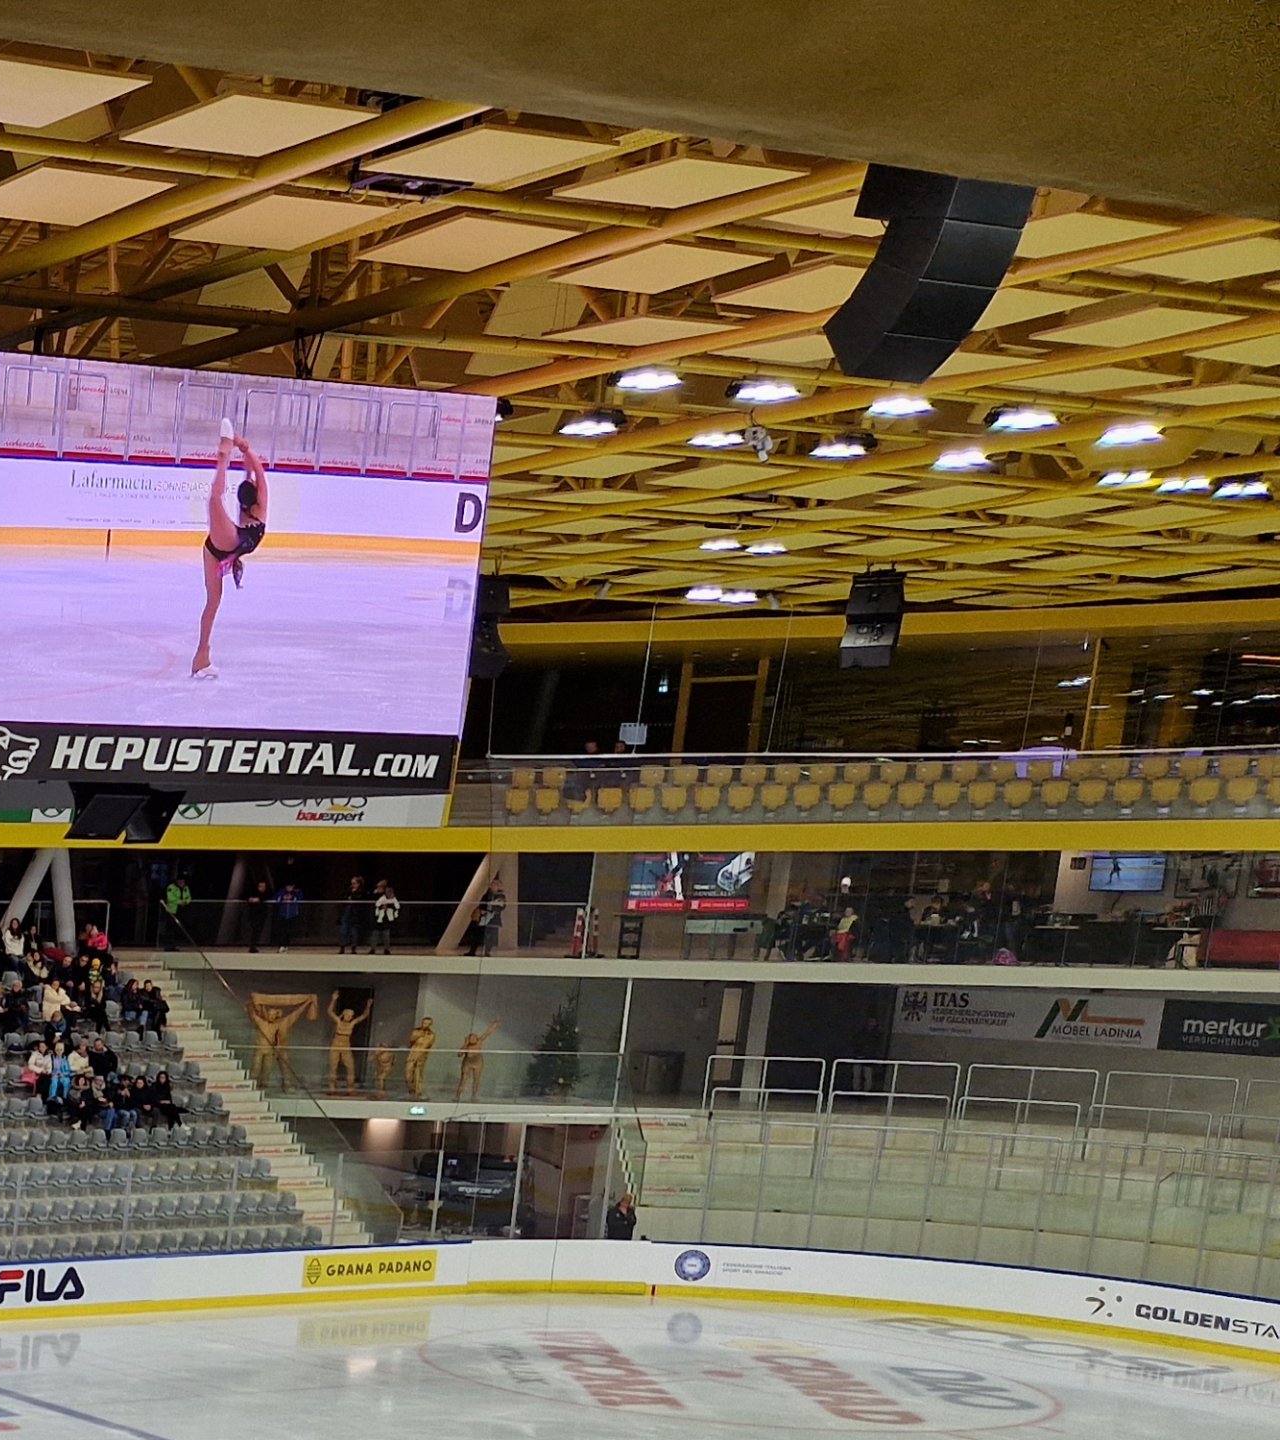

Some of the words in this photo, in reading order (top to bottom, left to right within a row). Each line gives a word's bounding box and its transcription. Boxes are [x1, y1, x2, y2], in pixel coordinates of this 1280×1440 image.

[454, 492, 482, 533] D
[50, 735, 440, 779] HCPUSTERTAL.COM
[296, 809, 365, 823] bauexpert
[932, 991, 970, 1008] ITAS
[1094, 1026, 1143, 1040] LADINIA
[1182, 1017, 1267, 1037] merkur
[1182, 1034, 1259, 1047] VERSICHERUNG
[326, 1260, 372, 1280] GRANA
[376, 1258, 433, 1277] PADANO
